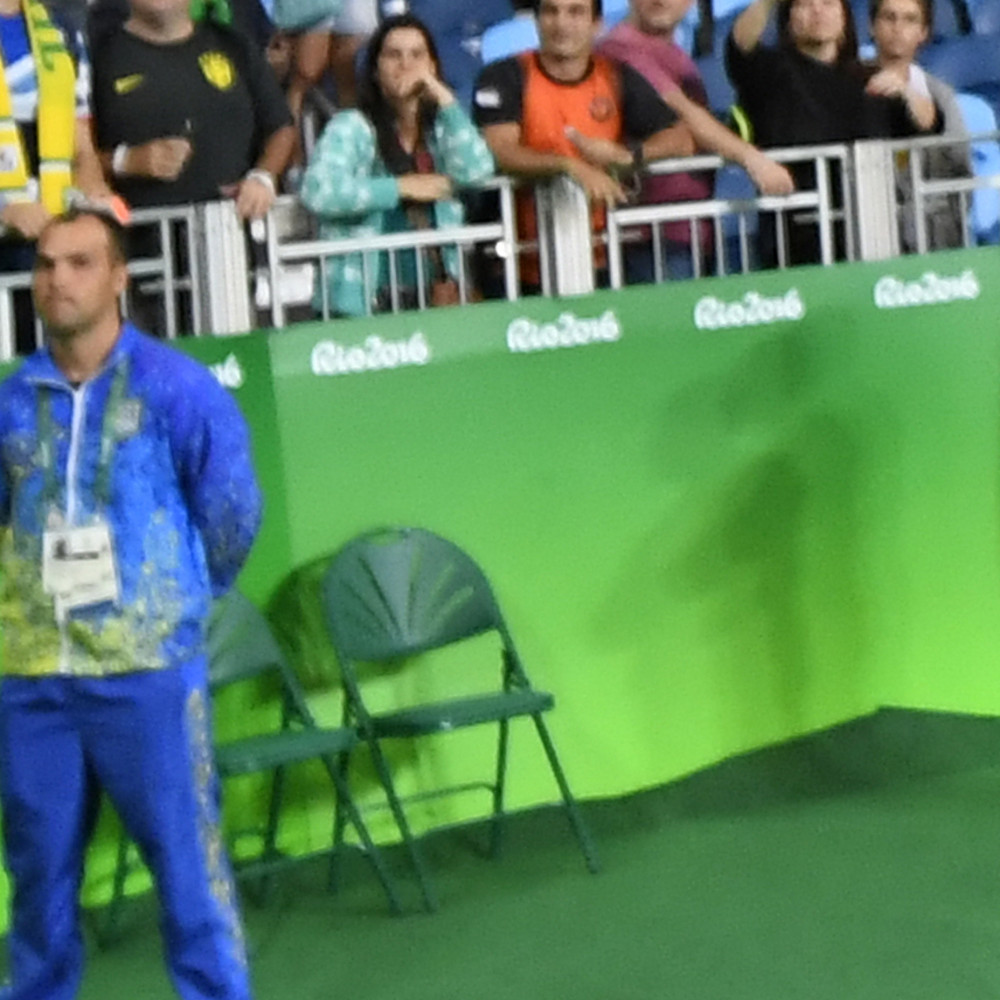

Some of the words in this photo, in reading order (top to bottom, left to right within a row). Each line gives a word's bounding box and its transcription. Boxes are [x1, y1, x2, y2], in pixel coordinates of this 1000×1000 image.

[694, 287, 805, 330] Rio2016
[874, 269, 980, 309] Rio2016
[506, 311, 621, 353] Rio2016
[311, 331, 429, 376] Rio2016
